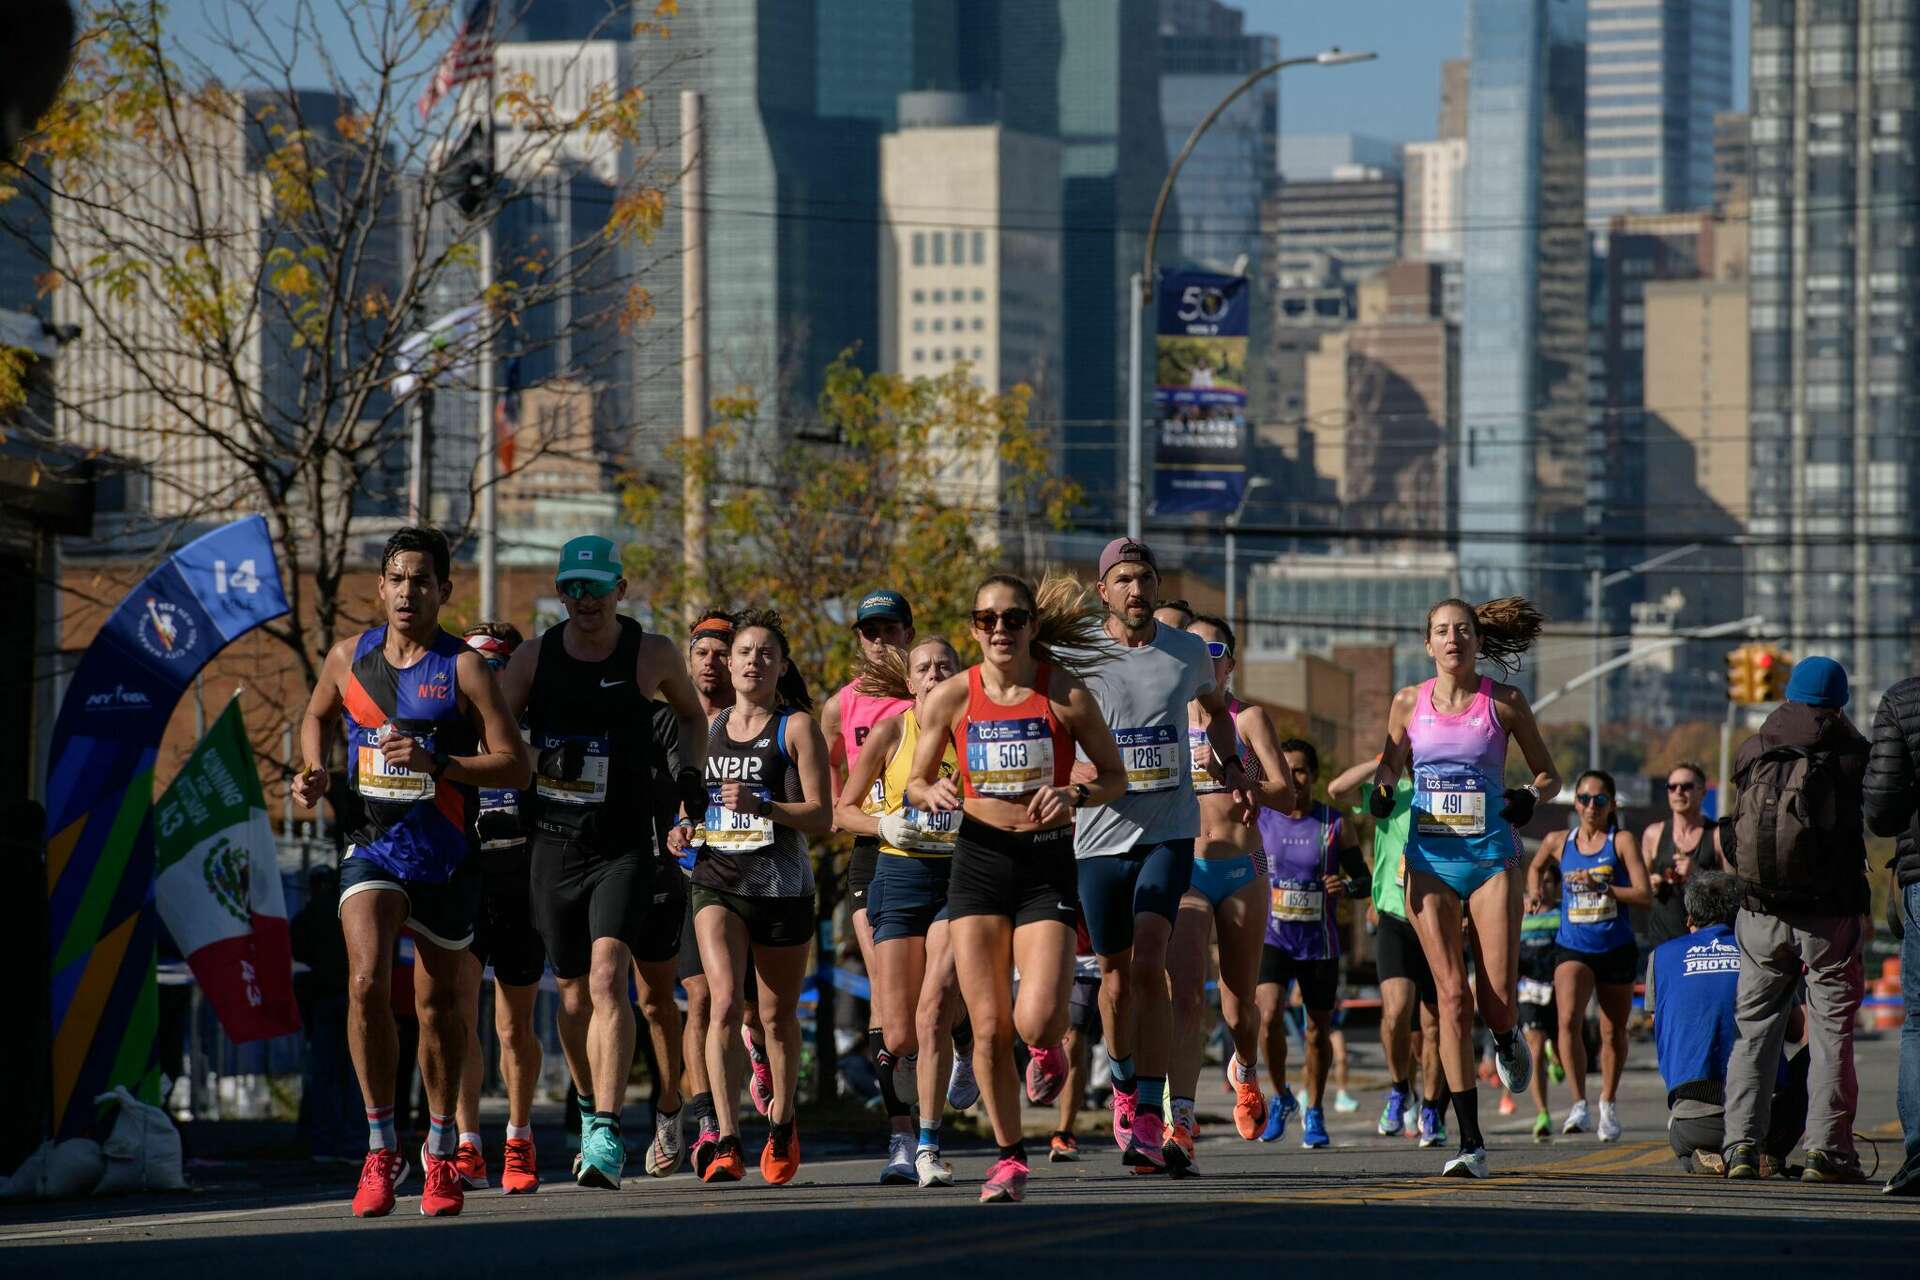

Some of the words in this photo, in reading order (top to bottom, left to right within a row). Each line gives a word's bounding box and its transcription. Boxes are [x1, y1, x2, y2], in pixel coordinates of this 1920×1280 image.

[1178, 286, 1229, 321] 50
[214, 559, 261, 594] 14
[418, 684, 448, 699] NYC
[979, 726, 998, 740] tcs
[1115, 733, 1134, 747] tcs
[1000, 743, 1028, 768] 503
[1133, 747, 1162, 769] 1285
[706, 757, 762, 780] NBR
[1427, 777, 1441, 789] tcs
[1443, 794, 1462, 814] 491
[927, 810, 952, 831] 490
[1033, 831, 1058, 843] NIKE
[1289, 891, 1309, 907] 1525
[1686, 959, 1740, 972] PHOTO
